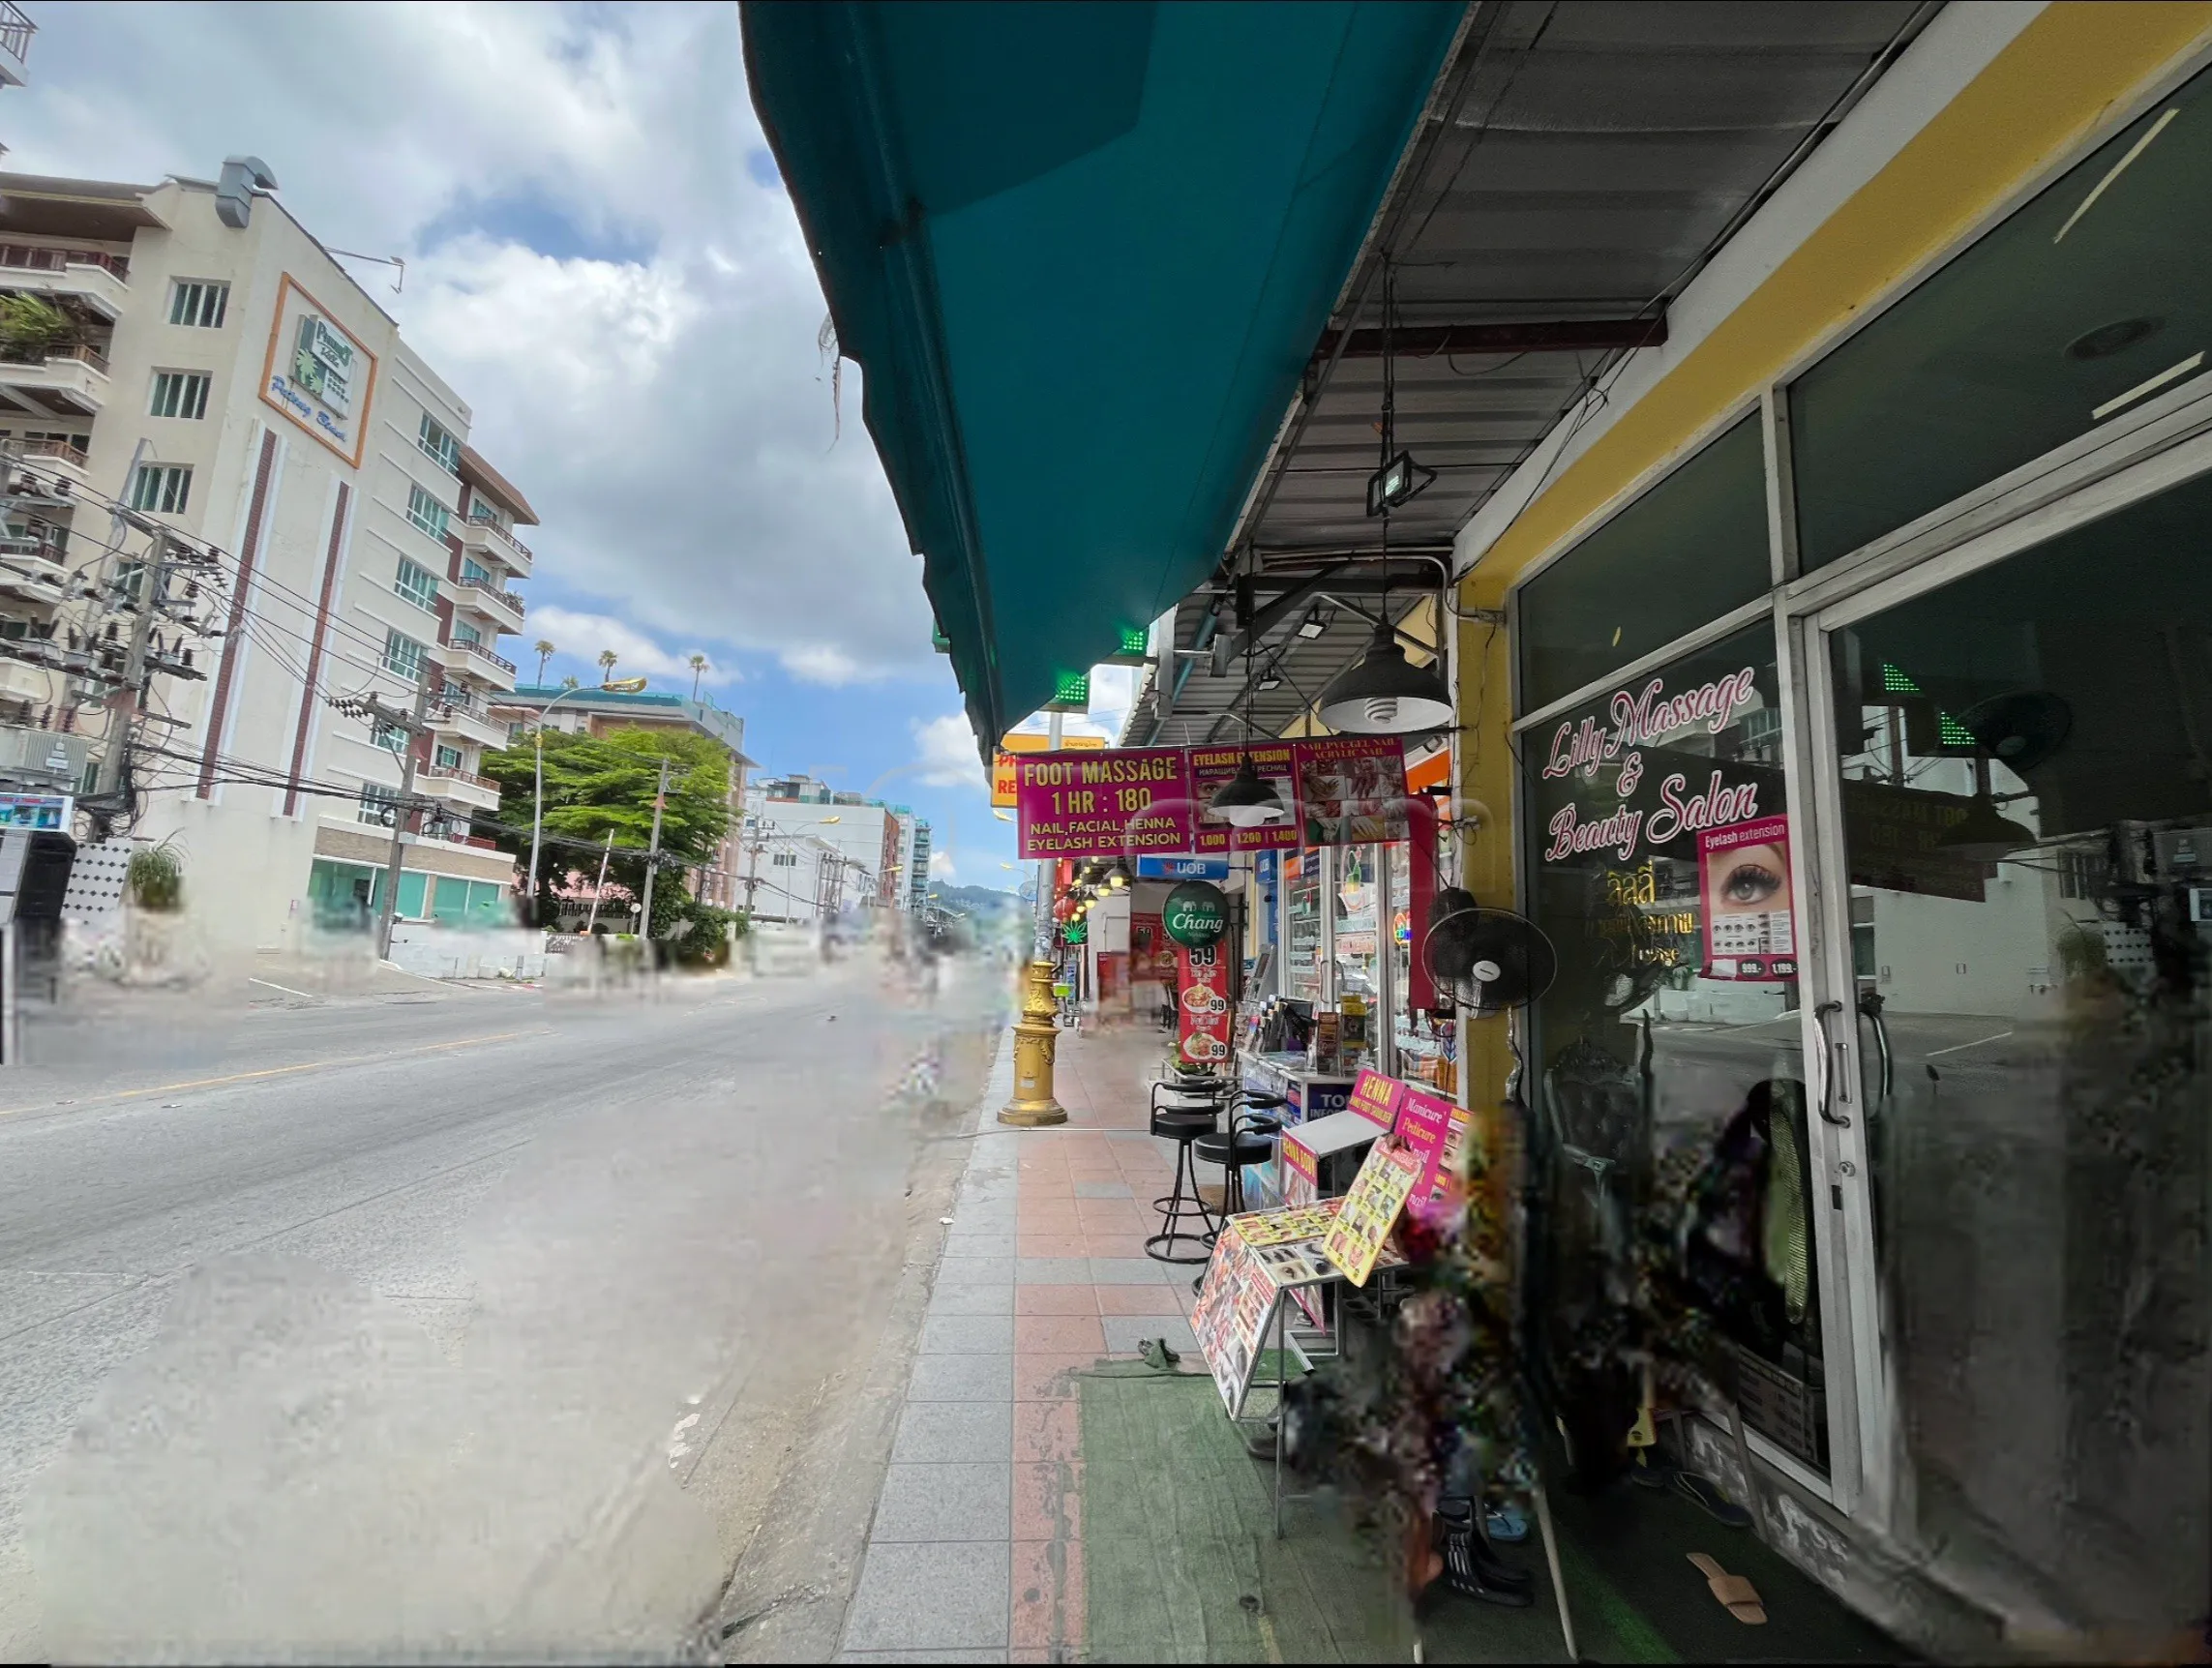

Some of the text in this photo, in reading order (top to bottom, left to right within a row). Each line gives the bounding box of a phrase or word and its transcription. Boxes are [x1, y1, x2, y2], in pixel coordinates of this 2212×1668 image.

[1542, 666, 1755, 780] Lilly Massage
[1193, 749, 1291, 766] EYELASH ETENSION
[1024, 757, 1178, 787] FOOT MASSAGE
[1617, 751, 1644, 798] &
[1051, 791, 1061, 815] 1
[1068, 789, 1094, 814] HR
[1115, 788, 1151, 812] 180
[1545, 770, 1758, 861] Beauty Salon
[1028, 833, 1181, 851] EYELASH EXTENSION
[1705, 823, 1785, 849] Eyelash extension
[1177, 862, 1207, 875] UOB
[1173, 912, 1224, 932] Chang
[1189, 945, 1216, 966] 59
[1211, 999, 1224, 1011] 99
[1211, 1044, 1225, 1057] 99
[1360, 1075, 1393, 1107] HENNA
[1406, 1097, 1443, 1124] Manicure
[1402, 1117, 1436, 1144] Pedicure
